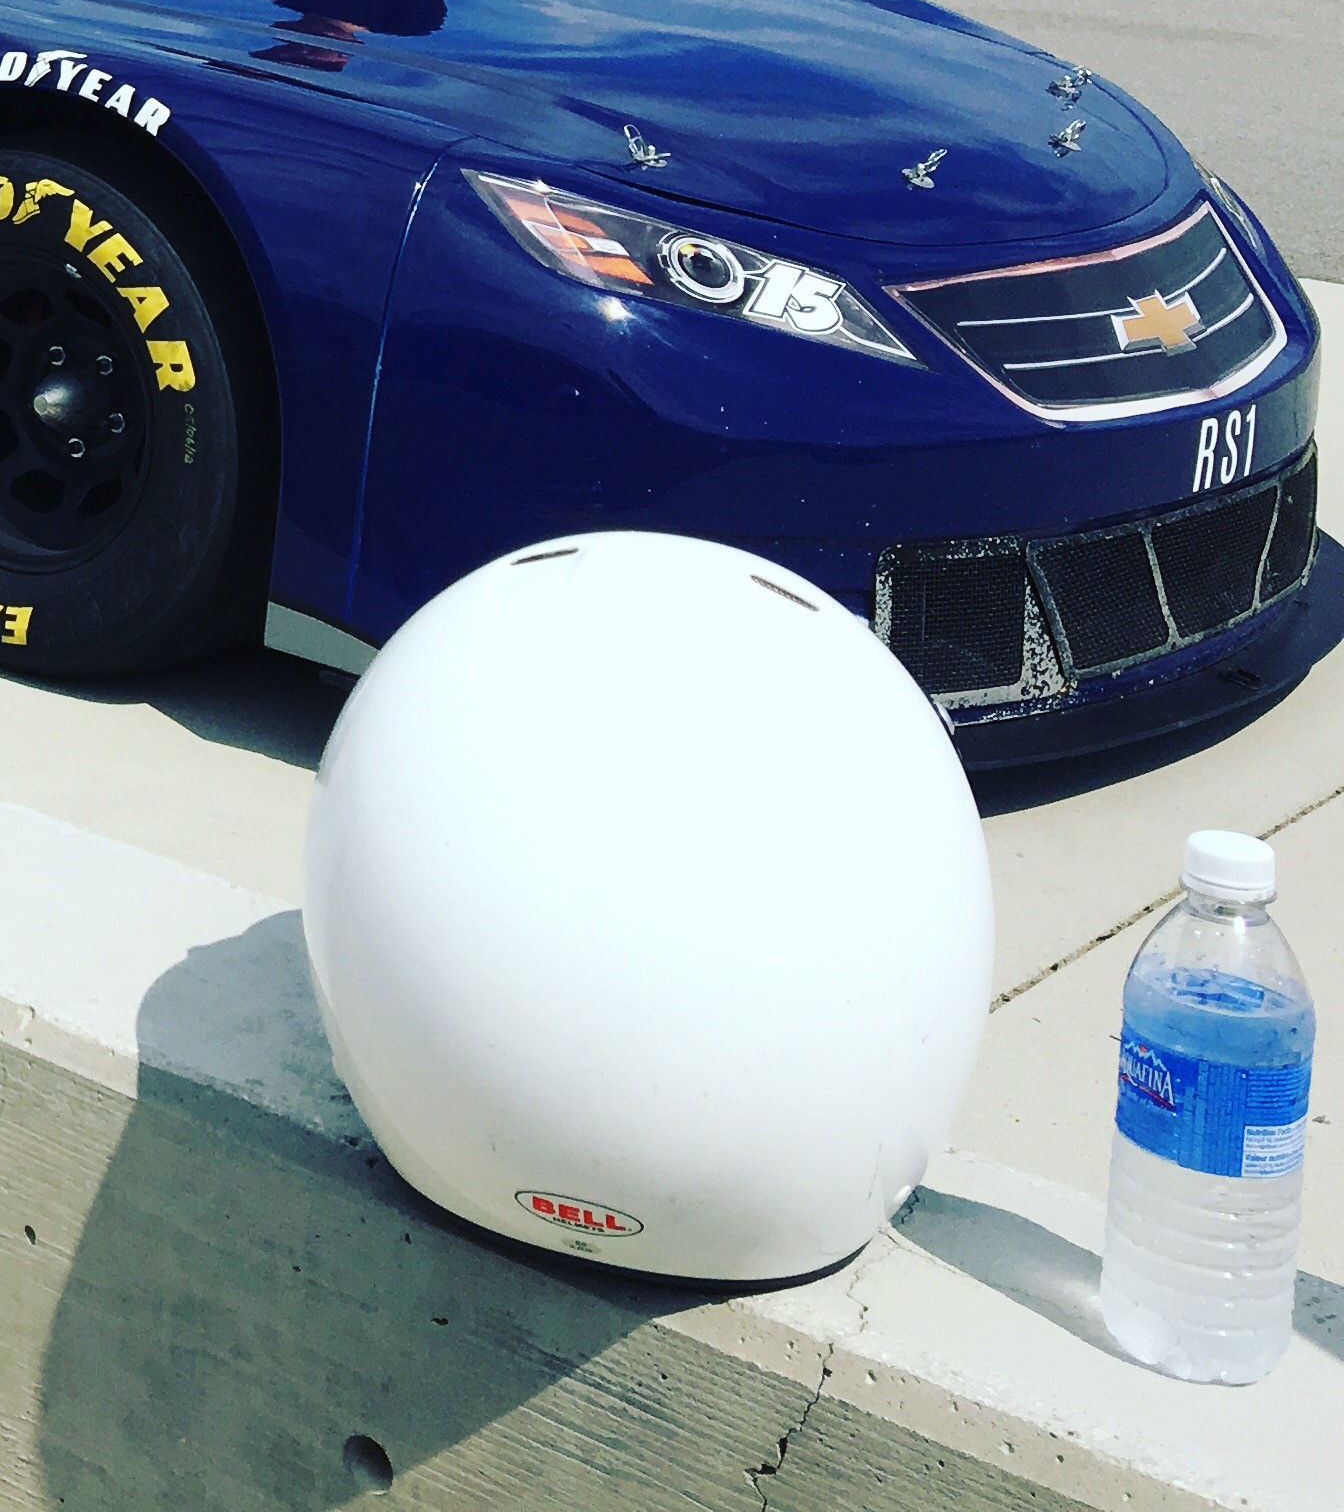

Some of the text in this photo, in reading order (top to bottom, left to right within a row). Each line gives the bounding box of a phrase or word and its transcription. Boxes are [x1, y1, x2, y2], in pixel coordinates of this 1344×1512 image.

[743, 258, 847, 335] 15
[1192, 404, 1256, 493] RS1
[532, 1196, 627, 1232] BELL
